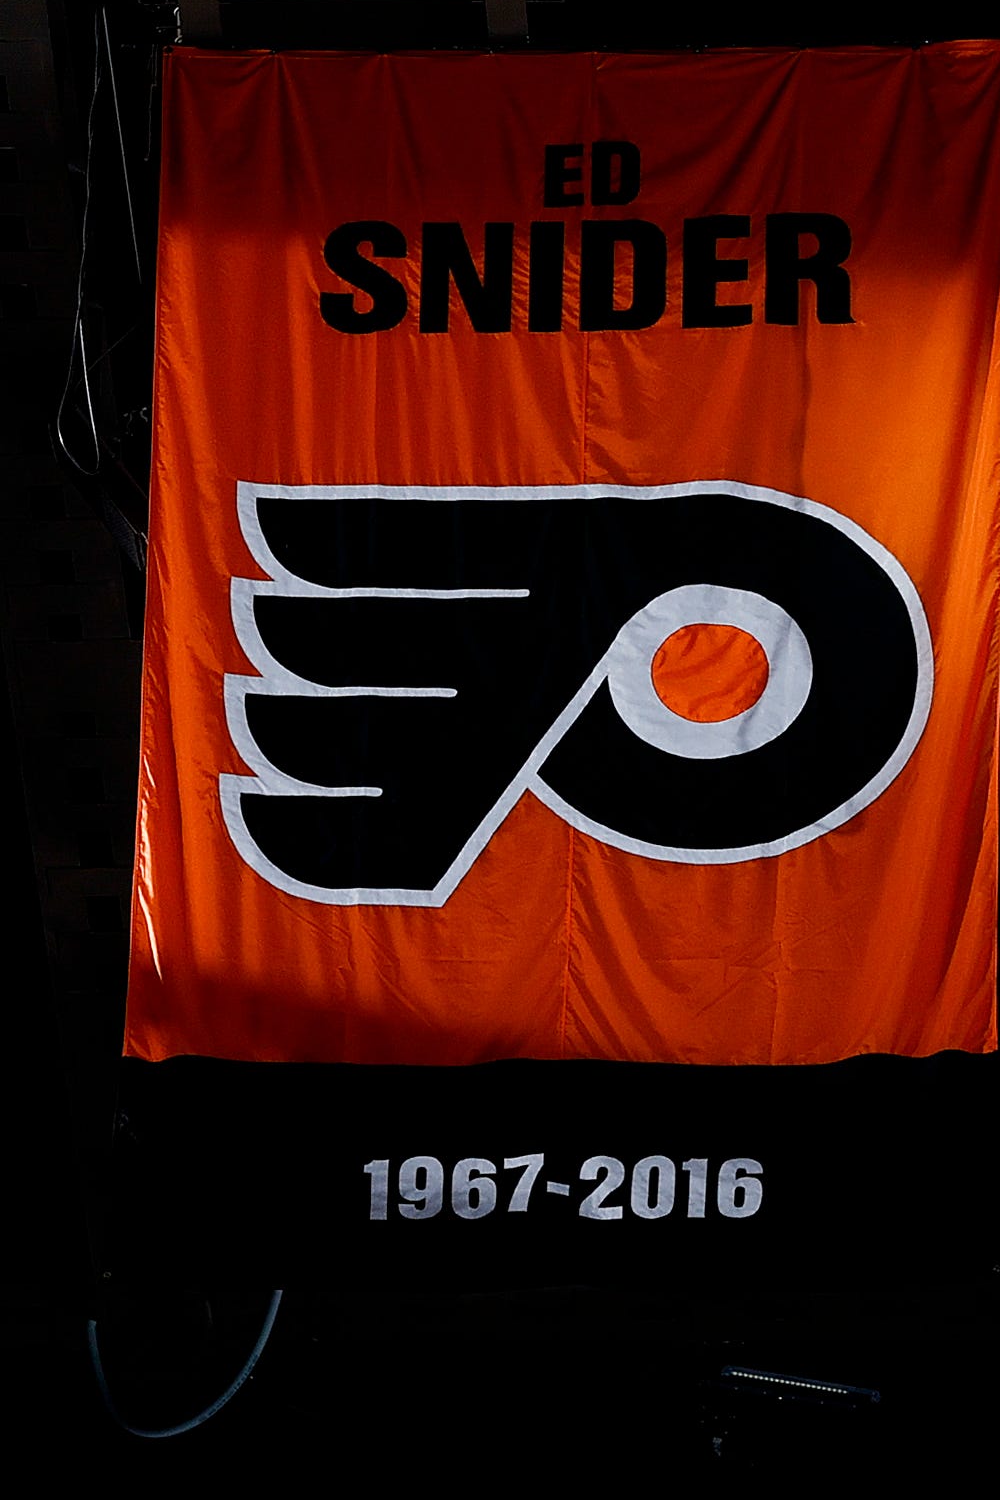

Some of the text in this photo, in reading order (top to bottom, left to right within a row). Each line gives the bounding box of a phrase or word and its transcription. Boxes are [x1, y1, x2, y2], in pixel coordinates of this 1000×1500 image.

[543, 140, 641, 208] ED
[319, 212, 856, 335] SNIDER
[363, 1152, 764, 1221] 1967-2016
